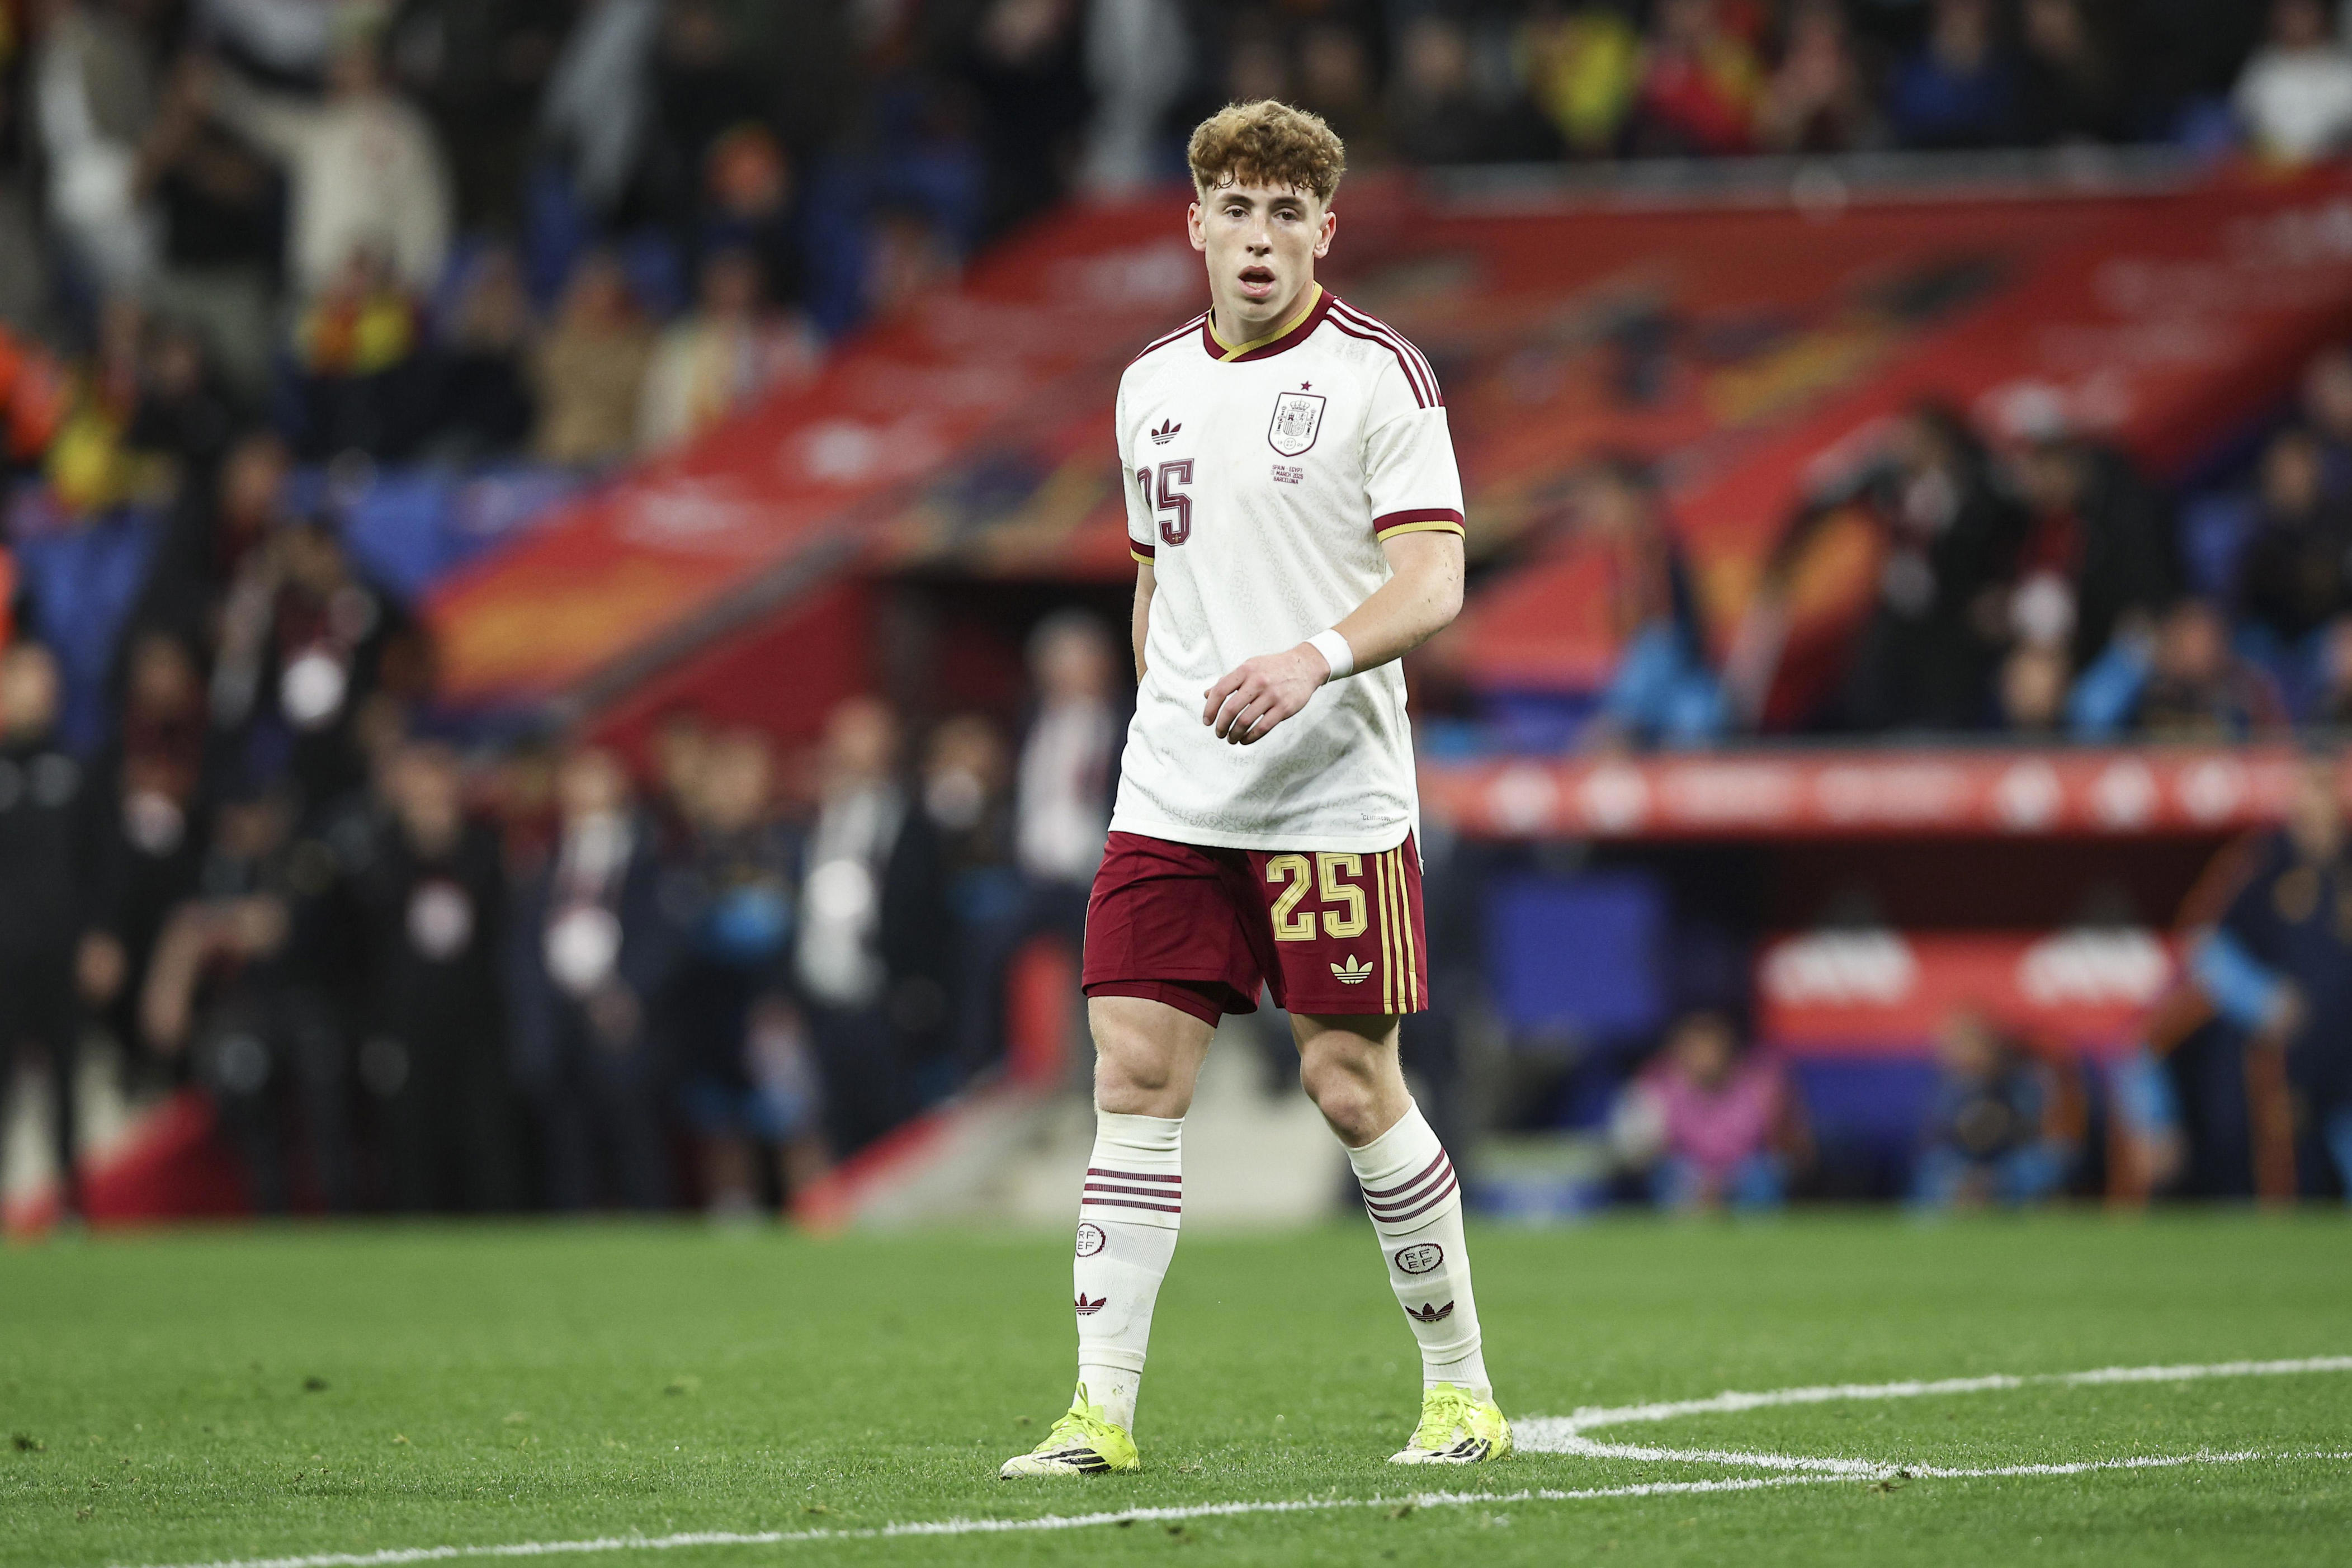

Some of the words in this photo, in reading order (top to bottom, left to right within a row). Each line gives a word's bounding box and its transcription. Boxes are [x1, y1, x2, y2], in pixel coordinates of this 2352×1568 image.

[1273, 476, 1298, 484] BARCELONA
[1266, 852, 1368, 941] 25
[1079, 1231, 1095, 1239] RF
[1078, 1241, 1094, 1250] EF
[1405, 1248, 1430, 1261] RF
[1408, 1257, 1433, 1269] EF
